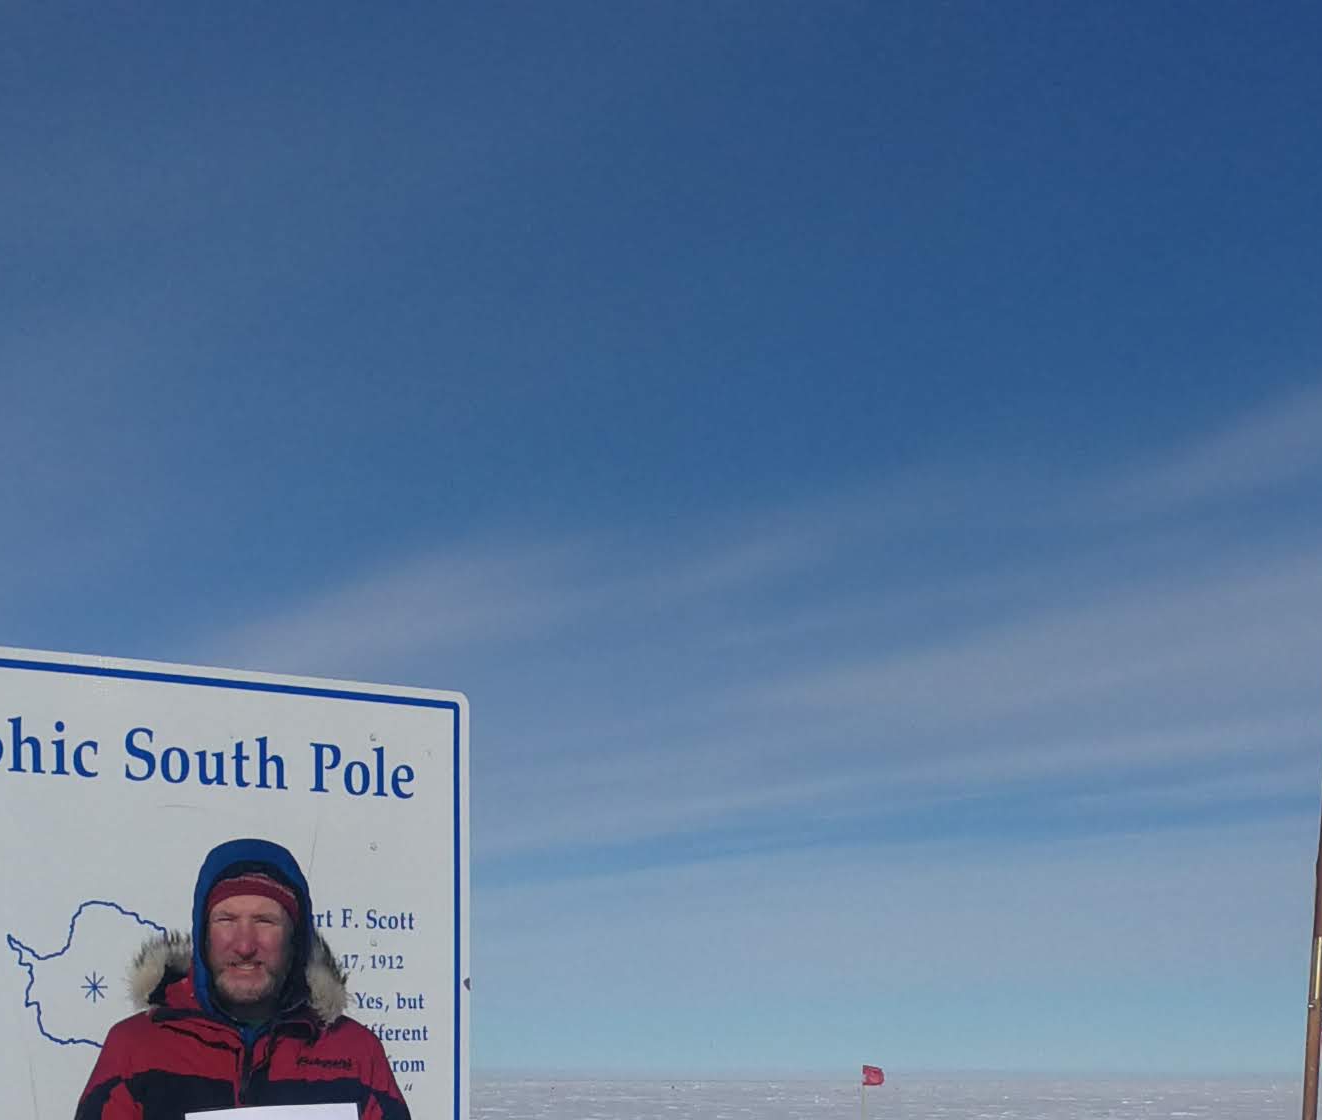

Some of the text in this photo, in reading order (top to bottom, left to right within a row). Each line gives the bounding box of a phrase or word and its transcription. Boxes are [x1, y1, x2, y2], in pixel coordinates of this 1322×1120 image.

[124, 727, 289, 791] South
[309, 742, 416, 799] Pole
[341, 908, 359, 929] F.
[365, 908, 415, 931] Scott
[343, 954, 404, 972] 17, 1912
[355, 991, 425, 1013] Yes, but
[365, 1023, 428, 1041] fferent
[388, 1055, 426, 1073] rom
